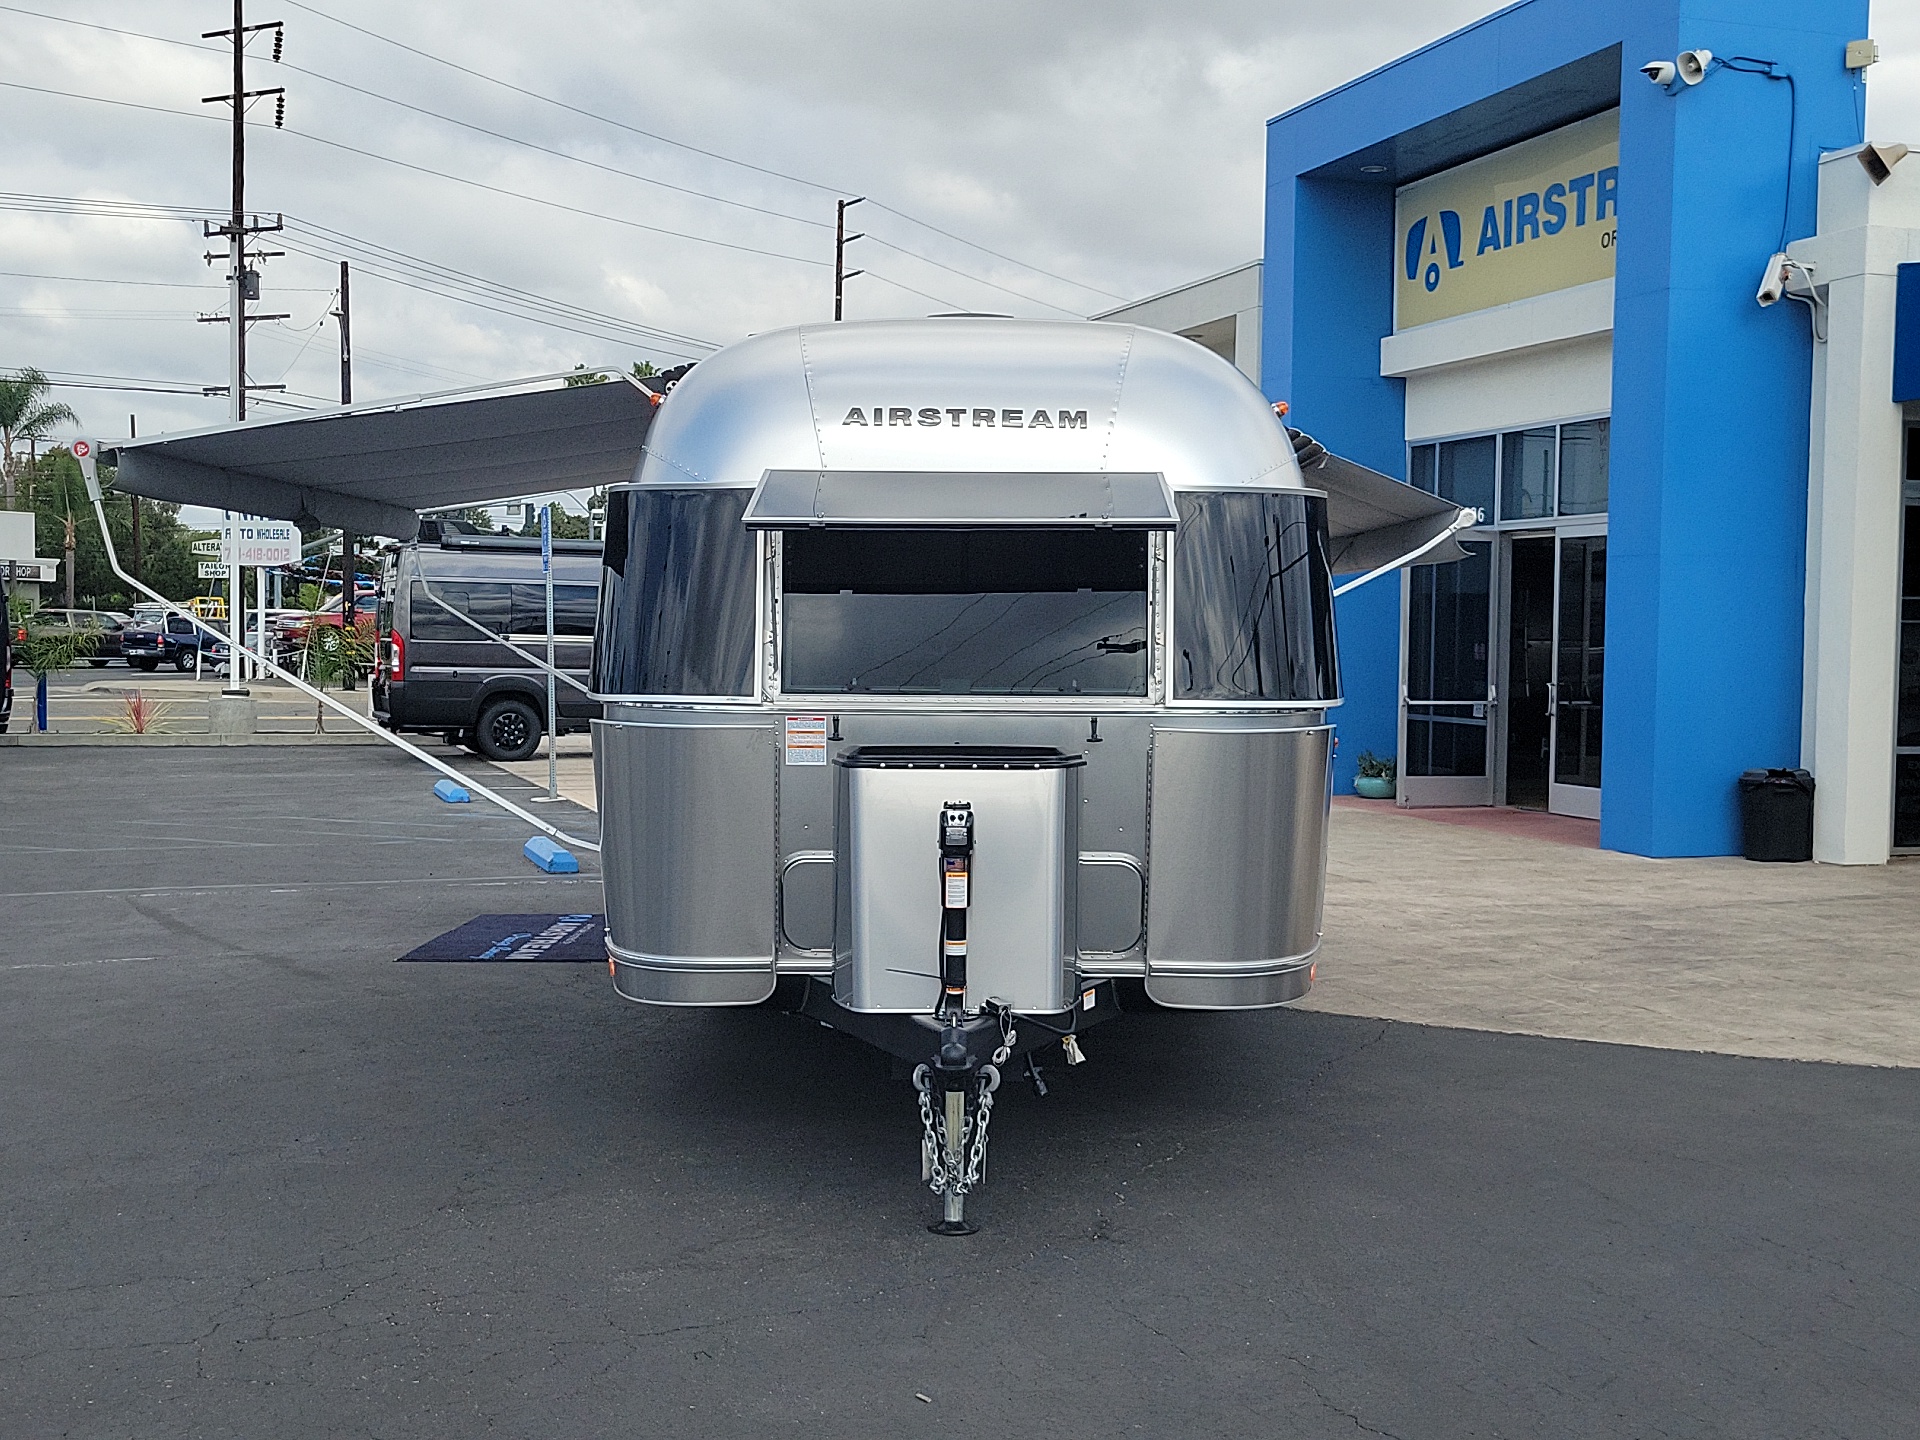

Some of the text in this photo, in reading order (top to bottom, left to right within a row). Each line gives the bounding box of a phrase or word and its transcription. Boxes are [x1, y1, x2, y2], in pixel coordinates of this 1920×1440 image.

[1477, 165, 1619, 256] AIRSTR
[842, 407, 1088, 429] AIRSTREAM
[225, 528, 290, 540] ATO WHOLESALE
[15, 566, 31, 577] HOP
